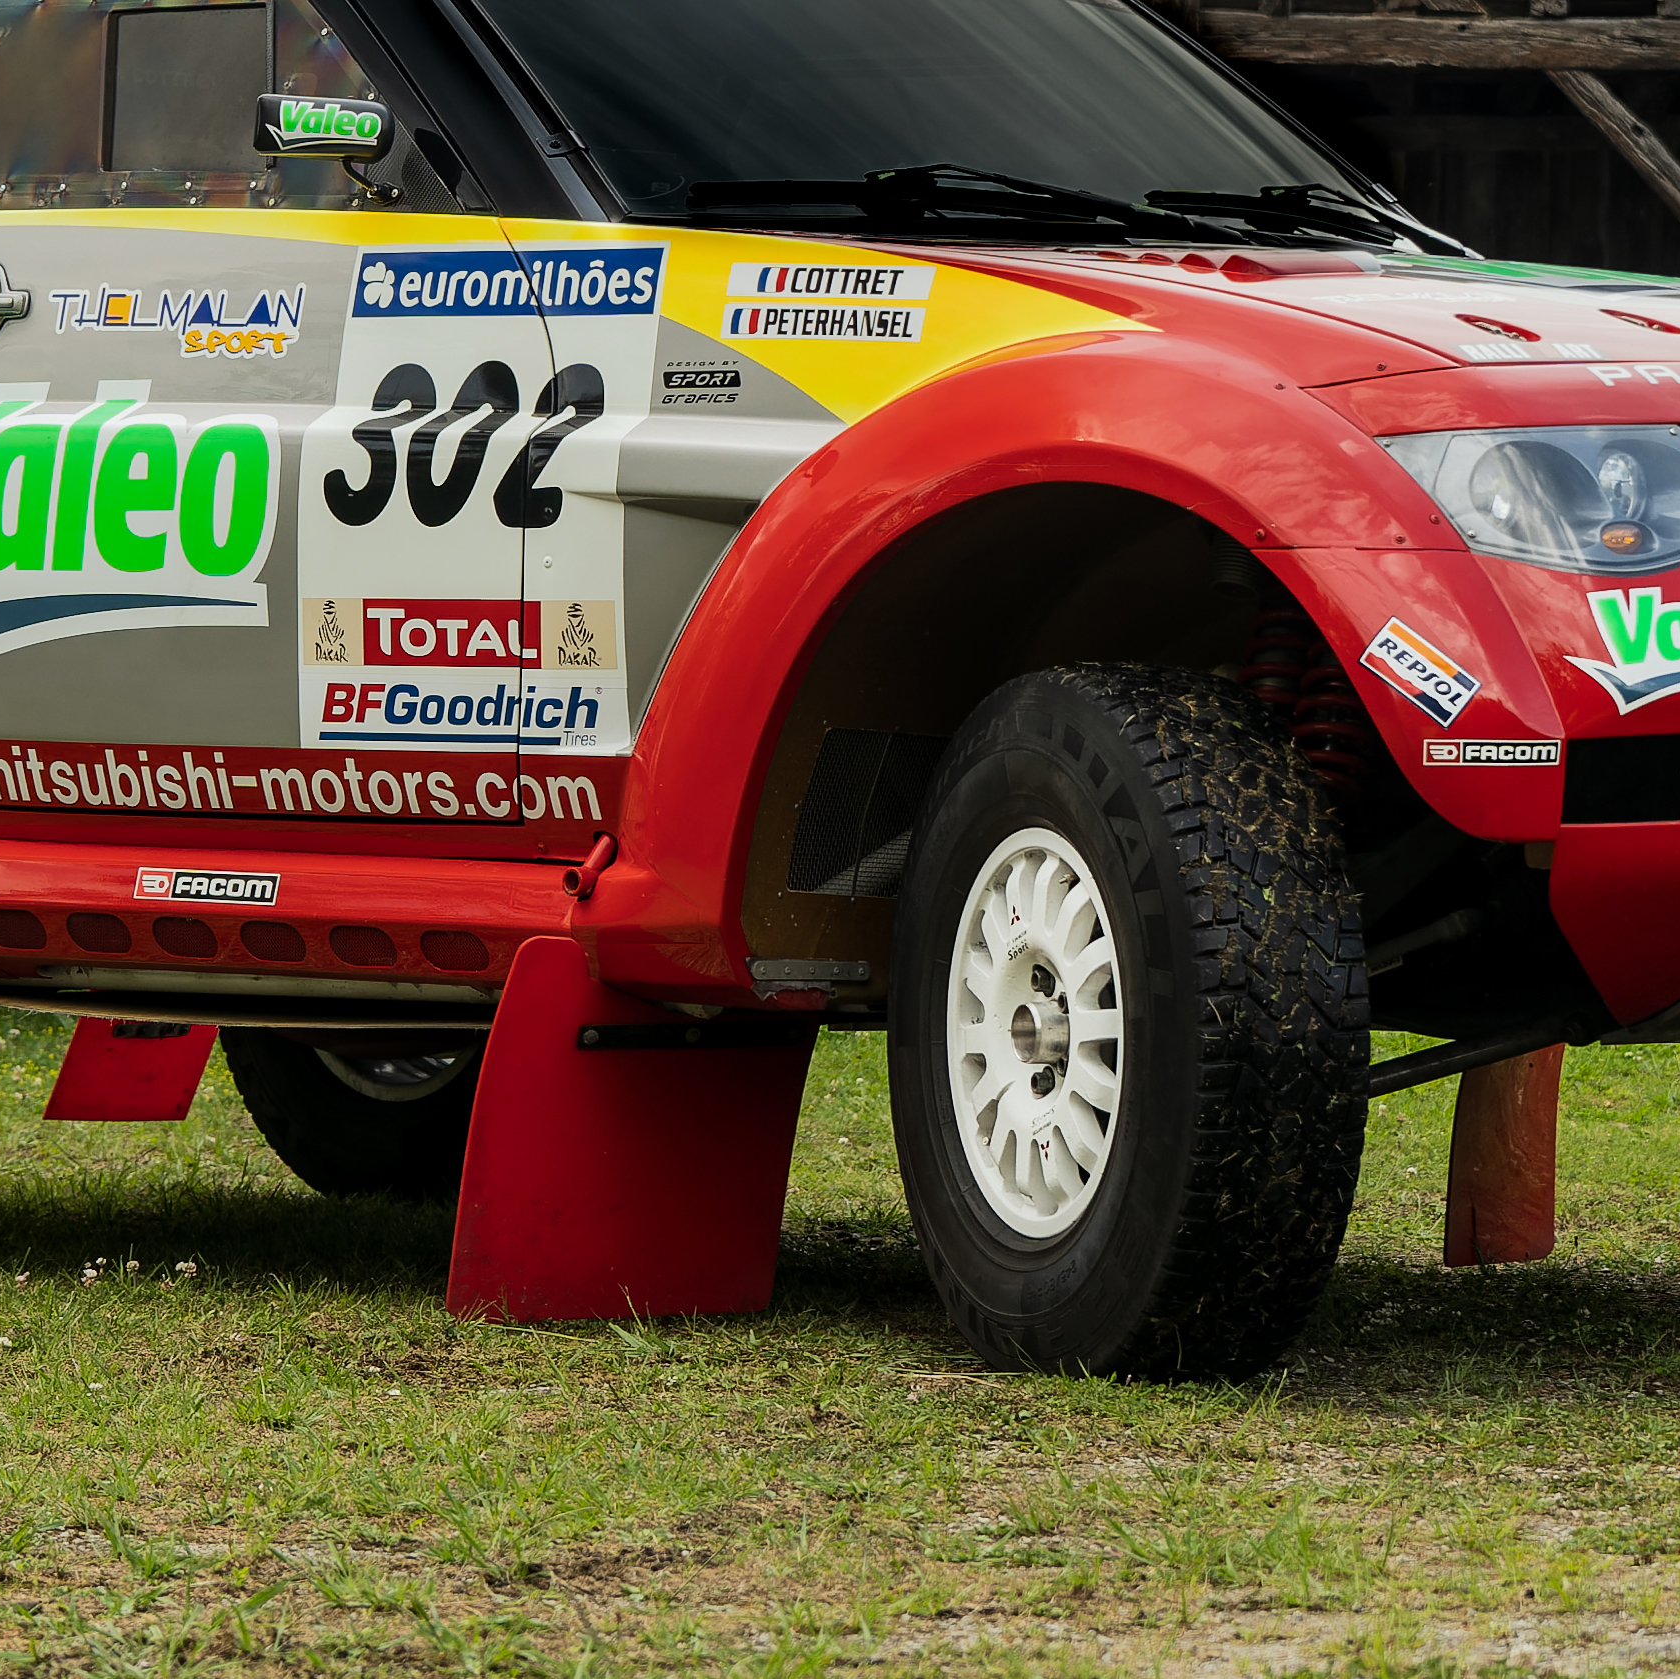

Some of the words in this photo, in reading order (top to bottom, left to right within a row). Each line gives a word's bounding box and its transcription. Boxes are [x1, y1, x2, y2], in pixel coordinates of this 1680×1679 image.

[282, 101, 380, 138] Valeo
[399, 259, 655, 314] euromilhões
[790, 268, 904, 295] COTTRET
[762, 308, 913, 338] PETERHANSEL
[183, 328, 293, 354] SPORT
[669, 373, 736, 386] SPORT
[322, 360, 606, 528] 302
[366, 607, 538, 659] TOTAL
[314, 641, 350, 664] DAKAR
[557, 645, 600, 668] DAKAR
[1376, 636, 1465, 709] REPSOL
[321, 682, 600, 729] BFGoodrich
[564, 732, 597, 746] Tires
[1465, 744, 1557, 761] FACOM
[174, 874, 277, 903] FACOM
